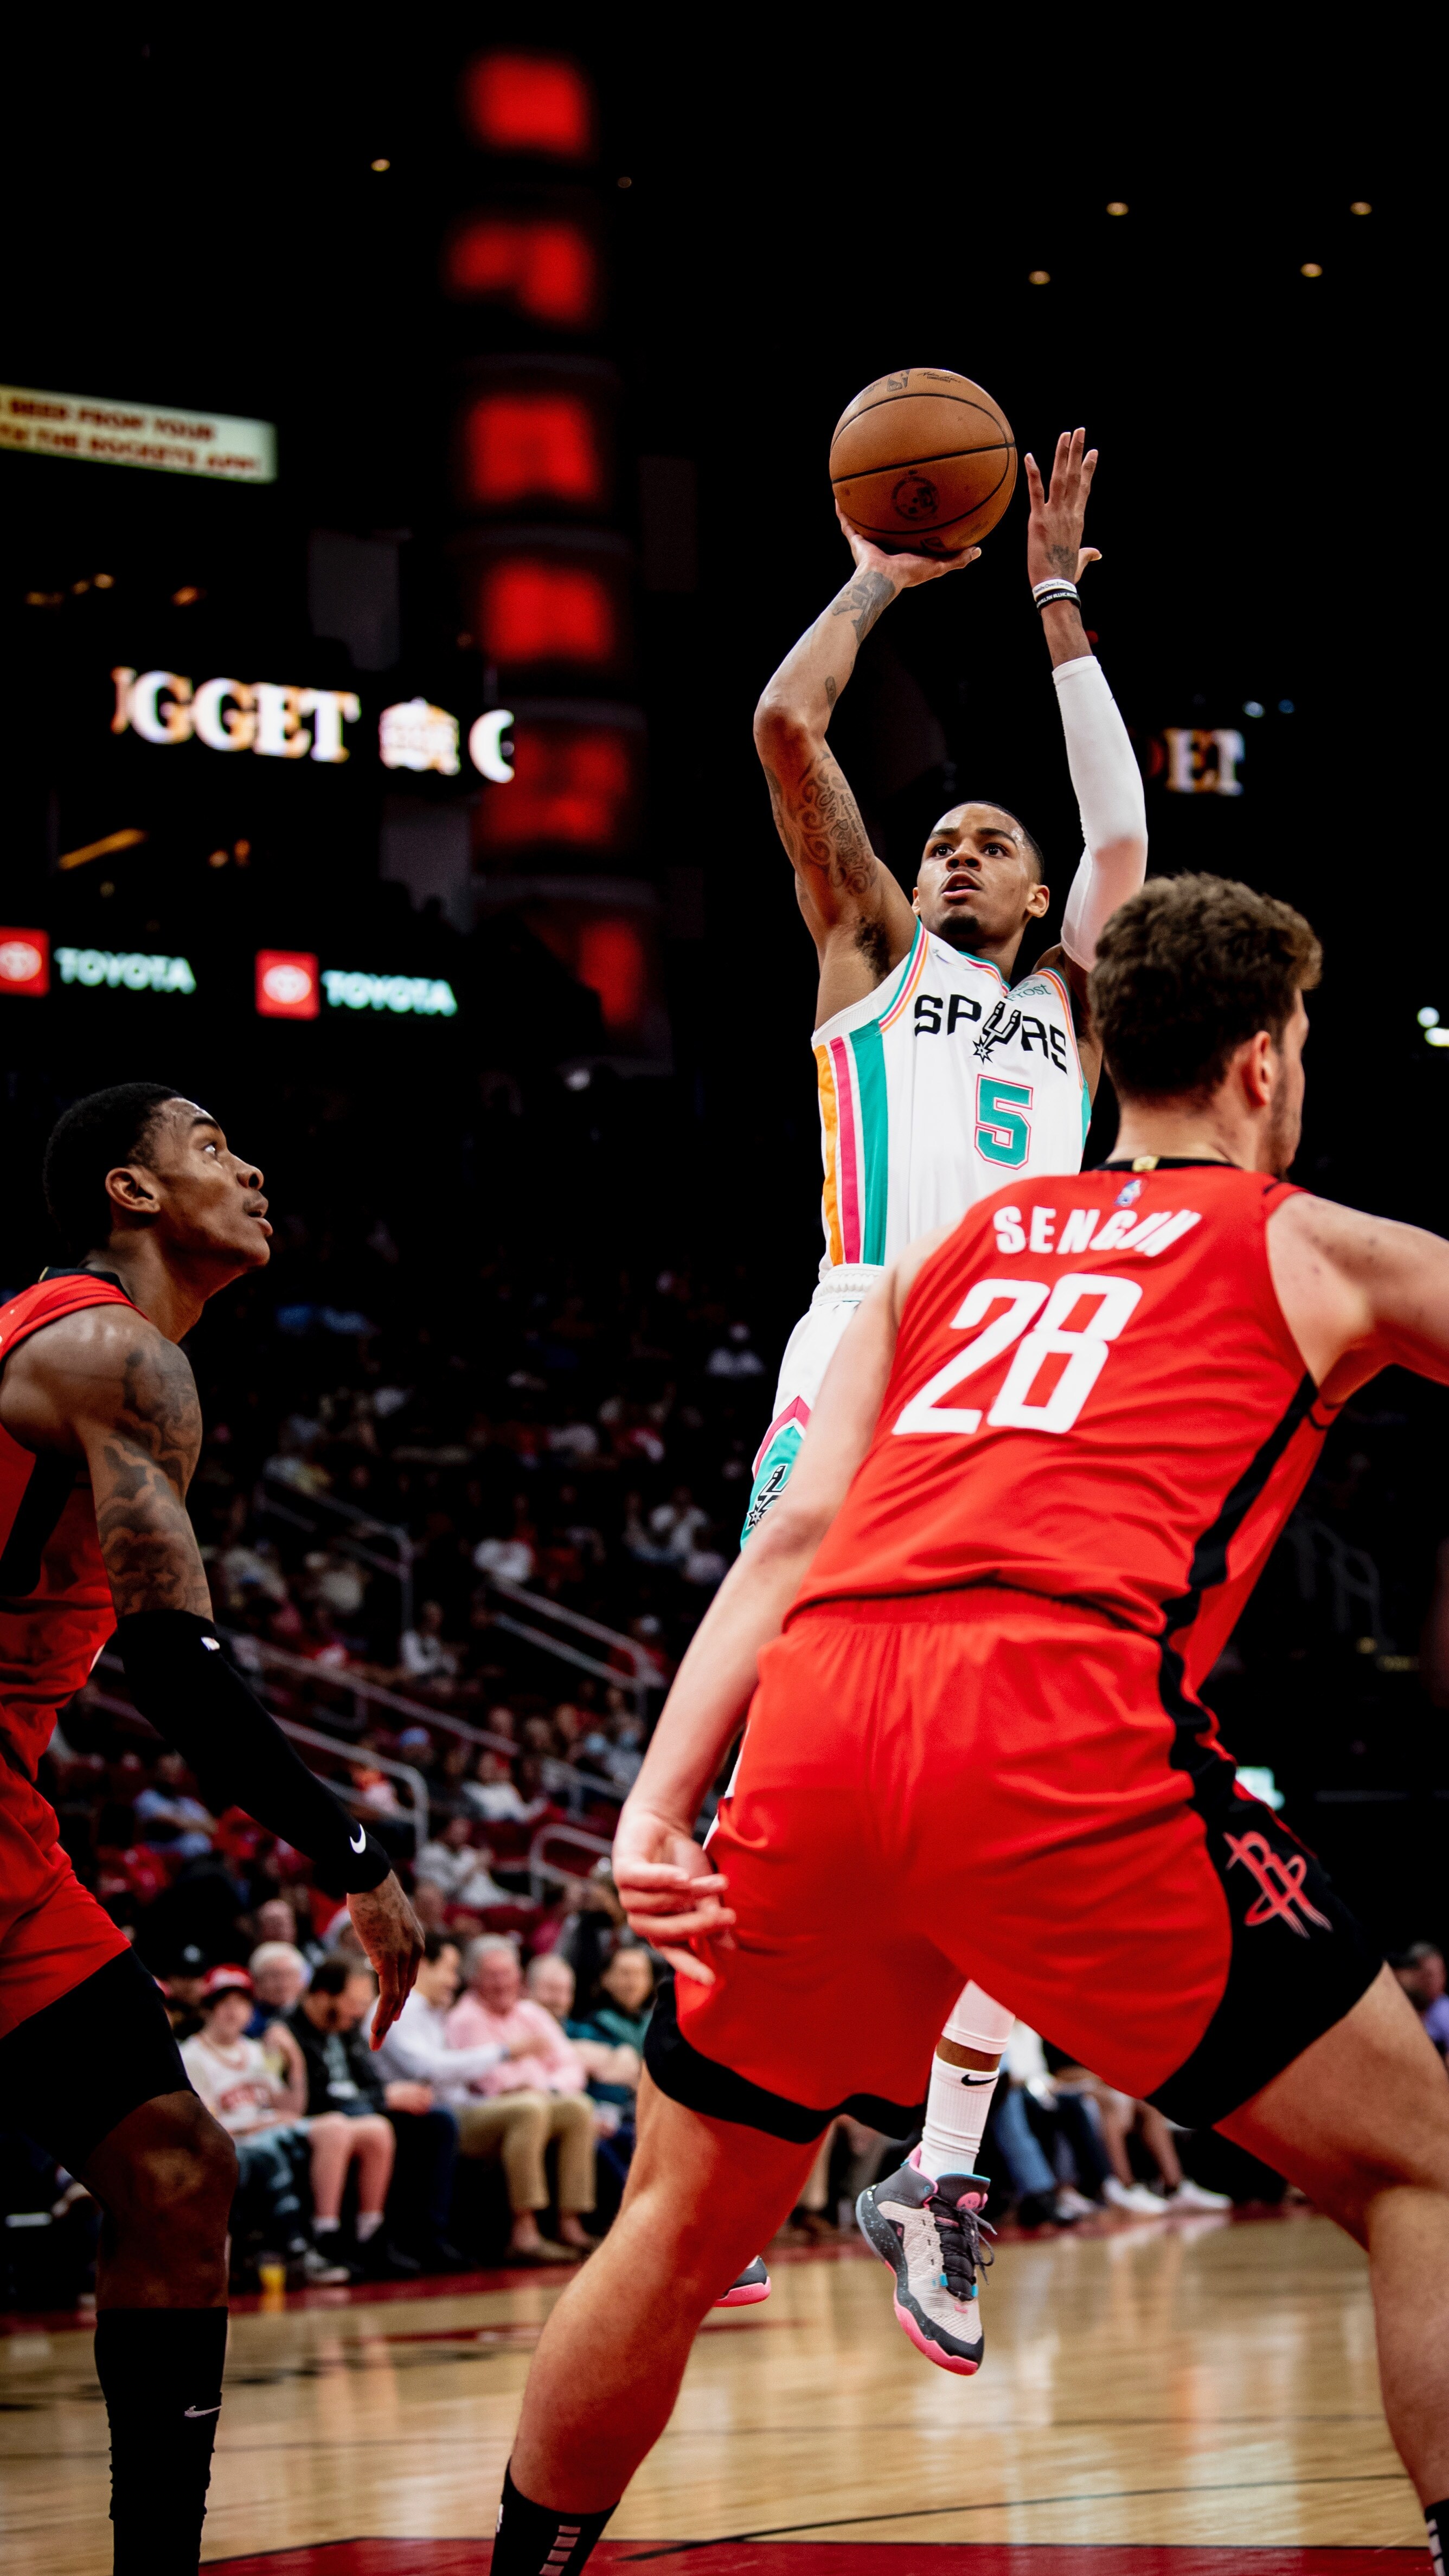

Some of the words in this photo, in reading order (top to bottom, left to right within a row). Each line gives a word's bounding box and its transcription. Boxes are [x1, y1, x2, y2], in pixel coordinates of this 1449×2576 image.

[54, 947, 196, 994] TOYOTA
[321, 969, 458, 1017] TOYOTA
[914, 994, 1067, 1075] SPURS
[974, 1074, 1034, 1170] 5
[891, 1272, 1143, 1435] 28
